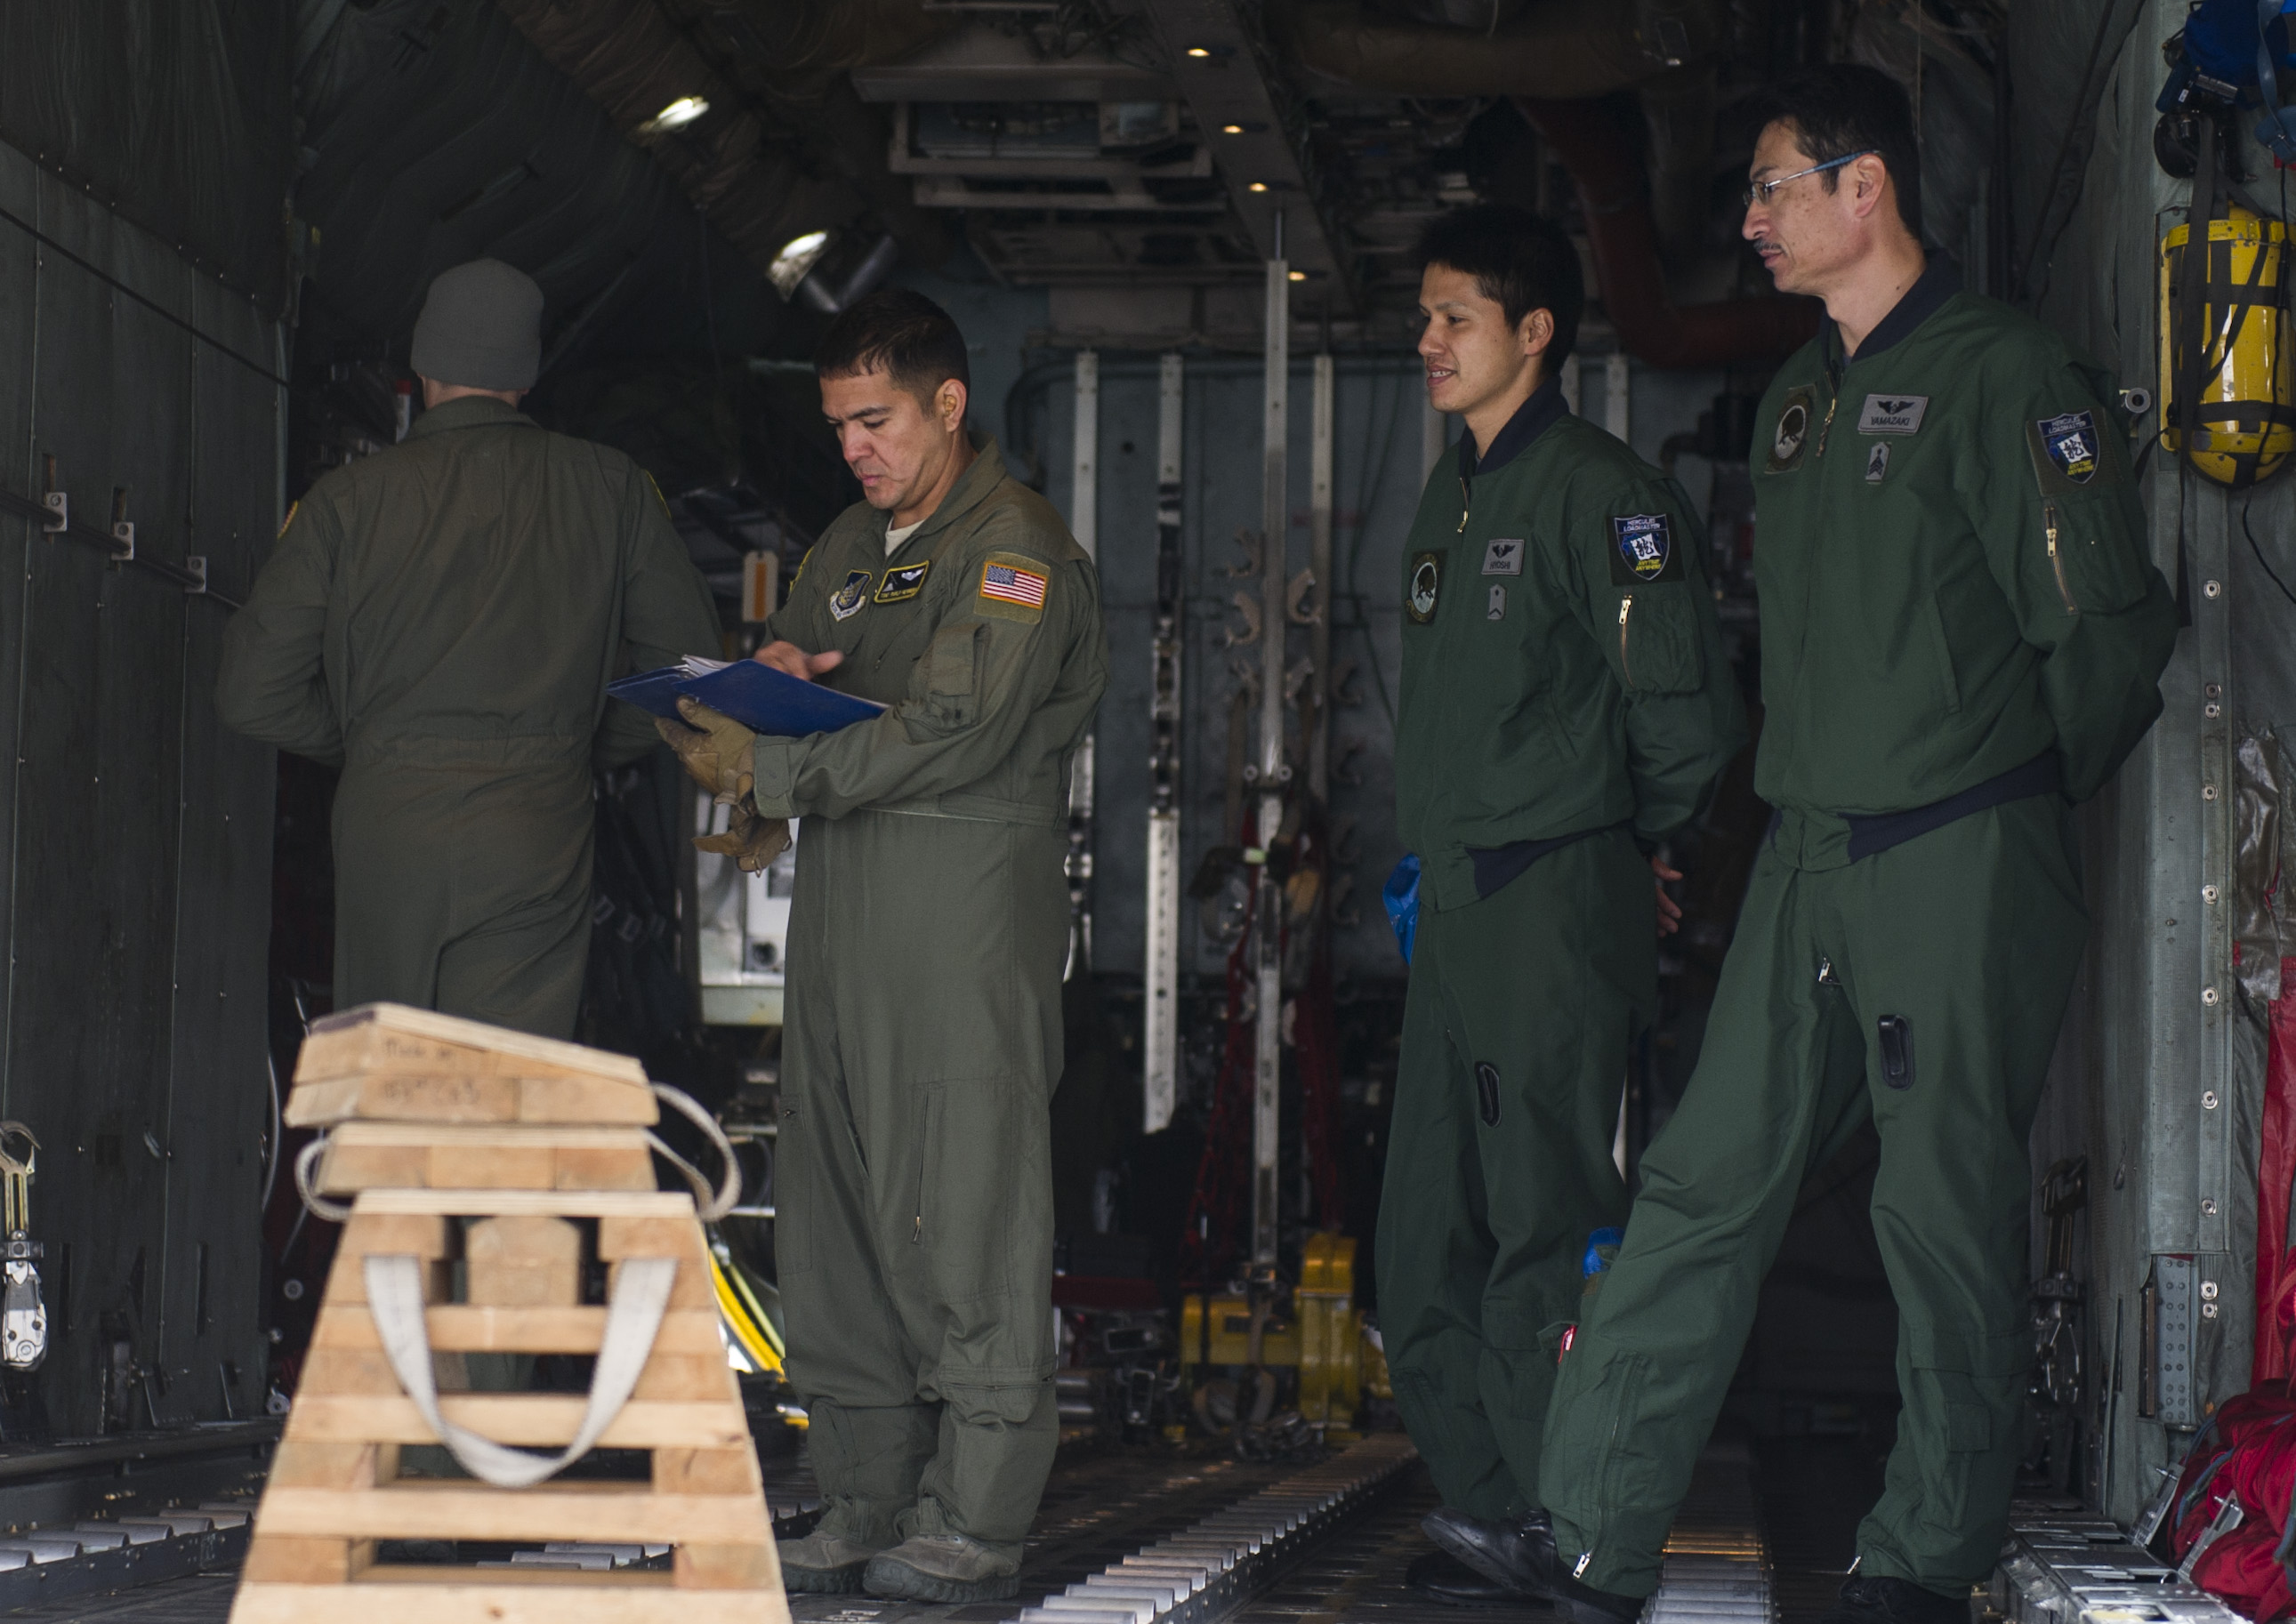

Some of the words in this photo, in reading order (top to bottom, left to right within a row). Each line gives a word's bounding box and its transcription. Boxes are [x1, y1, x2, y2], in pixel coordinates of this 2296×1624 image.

[1871, 416, 1911, 426] YAMAZAKI
[2049, 421, 2086, 434] LOADMASTER
[1627, 518, 1656, 526] HERCULES
[1623, 523, 1661, 532] LOADMASTER
